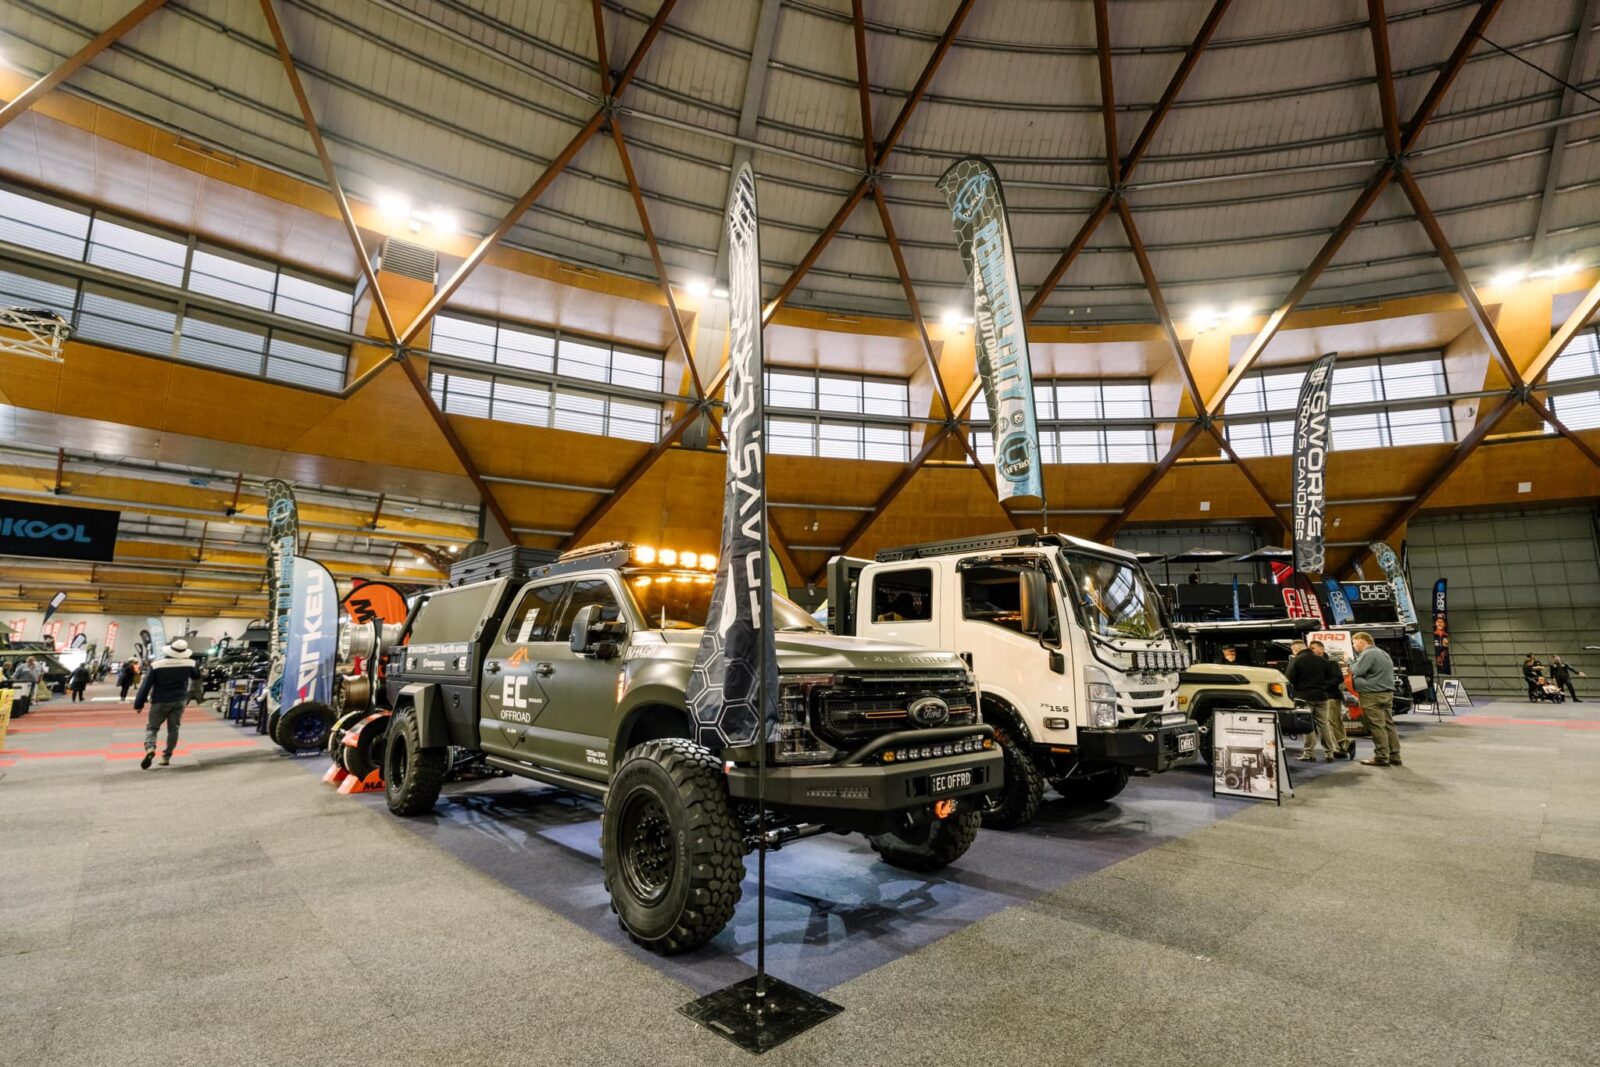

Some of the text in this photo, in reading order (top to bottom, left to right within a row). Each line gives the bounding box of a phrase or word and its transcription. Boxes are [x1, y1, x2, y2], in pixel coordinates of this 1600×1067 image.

[997, 334, 1025, 400] CITY
[1295, 392, 1310, 541] TRAYS, CANOPIES
[1306, 390, 1328, 541] GWORKS.
[0, 517, 92, 544] KOOL
[1313, 633, 1346, 641] RAD
[502, 675, 529, 709] EC
[500, 709, 531, 723] OFFROAD
[923, 706, 942, 719] Ford
[936, 775, 946, 792] EC
[947, 772, 971, 788] OFFRD
